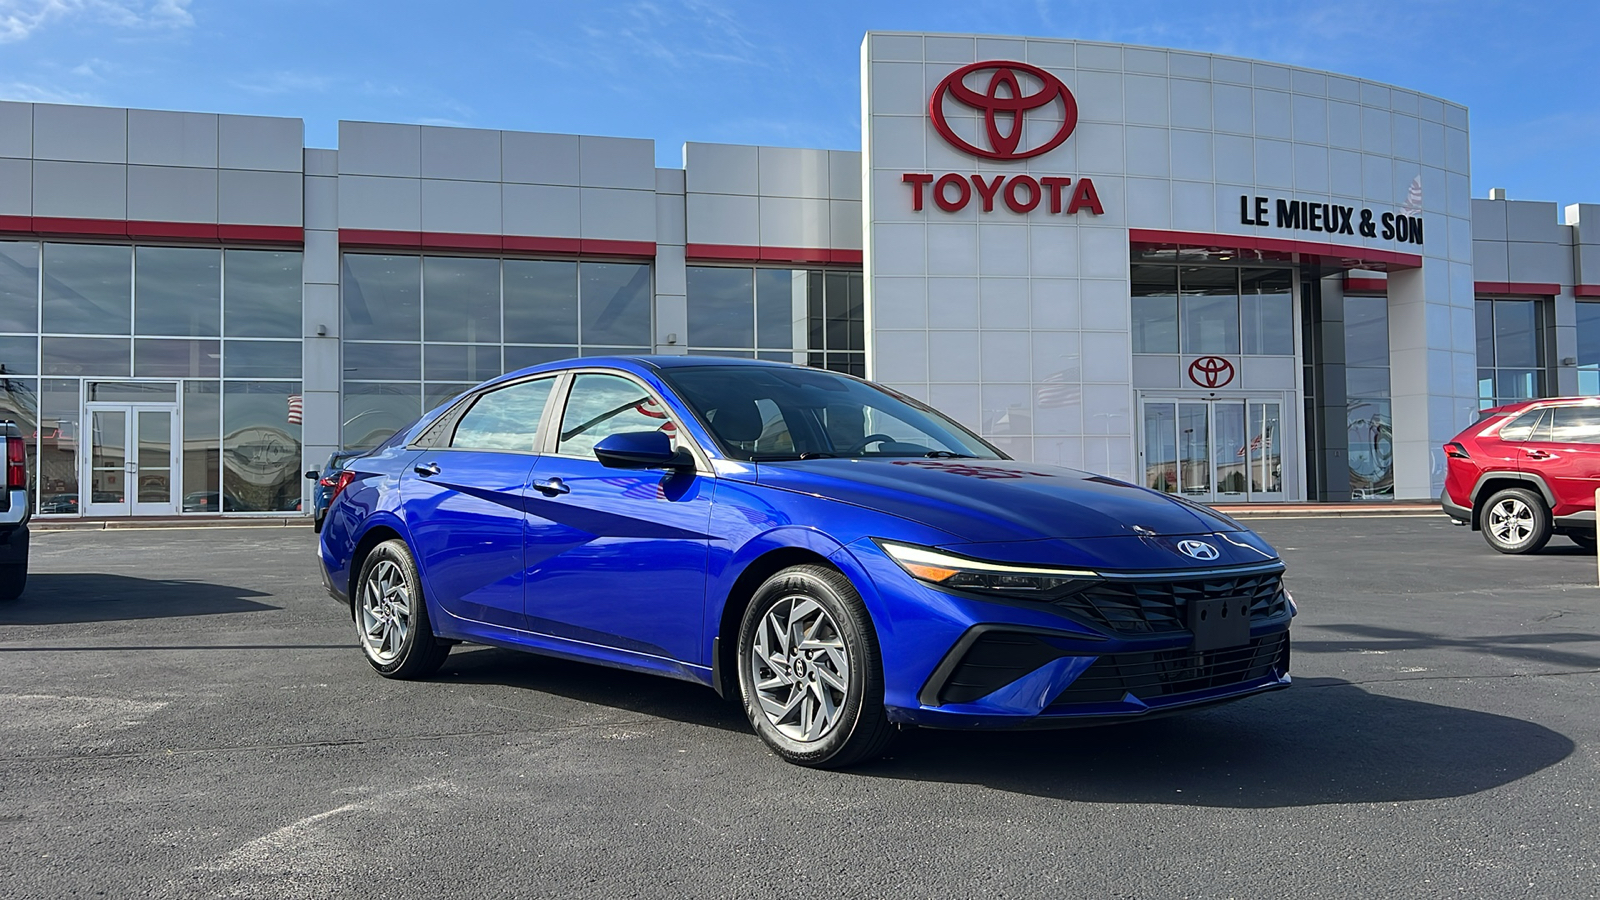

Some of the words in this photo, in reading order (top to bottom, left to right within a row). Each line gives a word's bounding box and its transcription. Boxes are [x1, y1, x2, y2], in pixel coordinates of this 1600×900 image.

[902, 173, 1104, 215] TOYOTA
[1240, 195, 1269, 226] LE
[1276, 199, 1354, 235] MIEUX
[1359, 209, 1377, 238] &
[1381, 212, 1423, 244] SON
